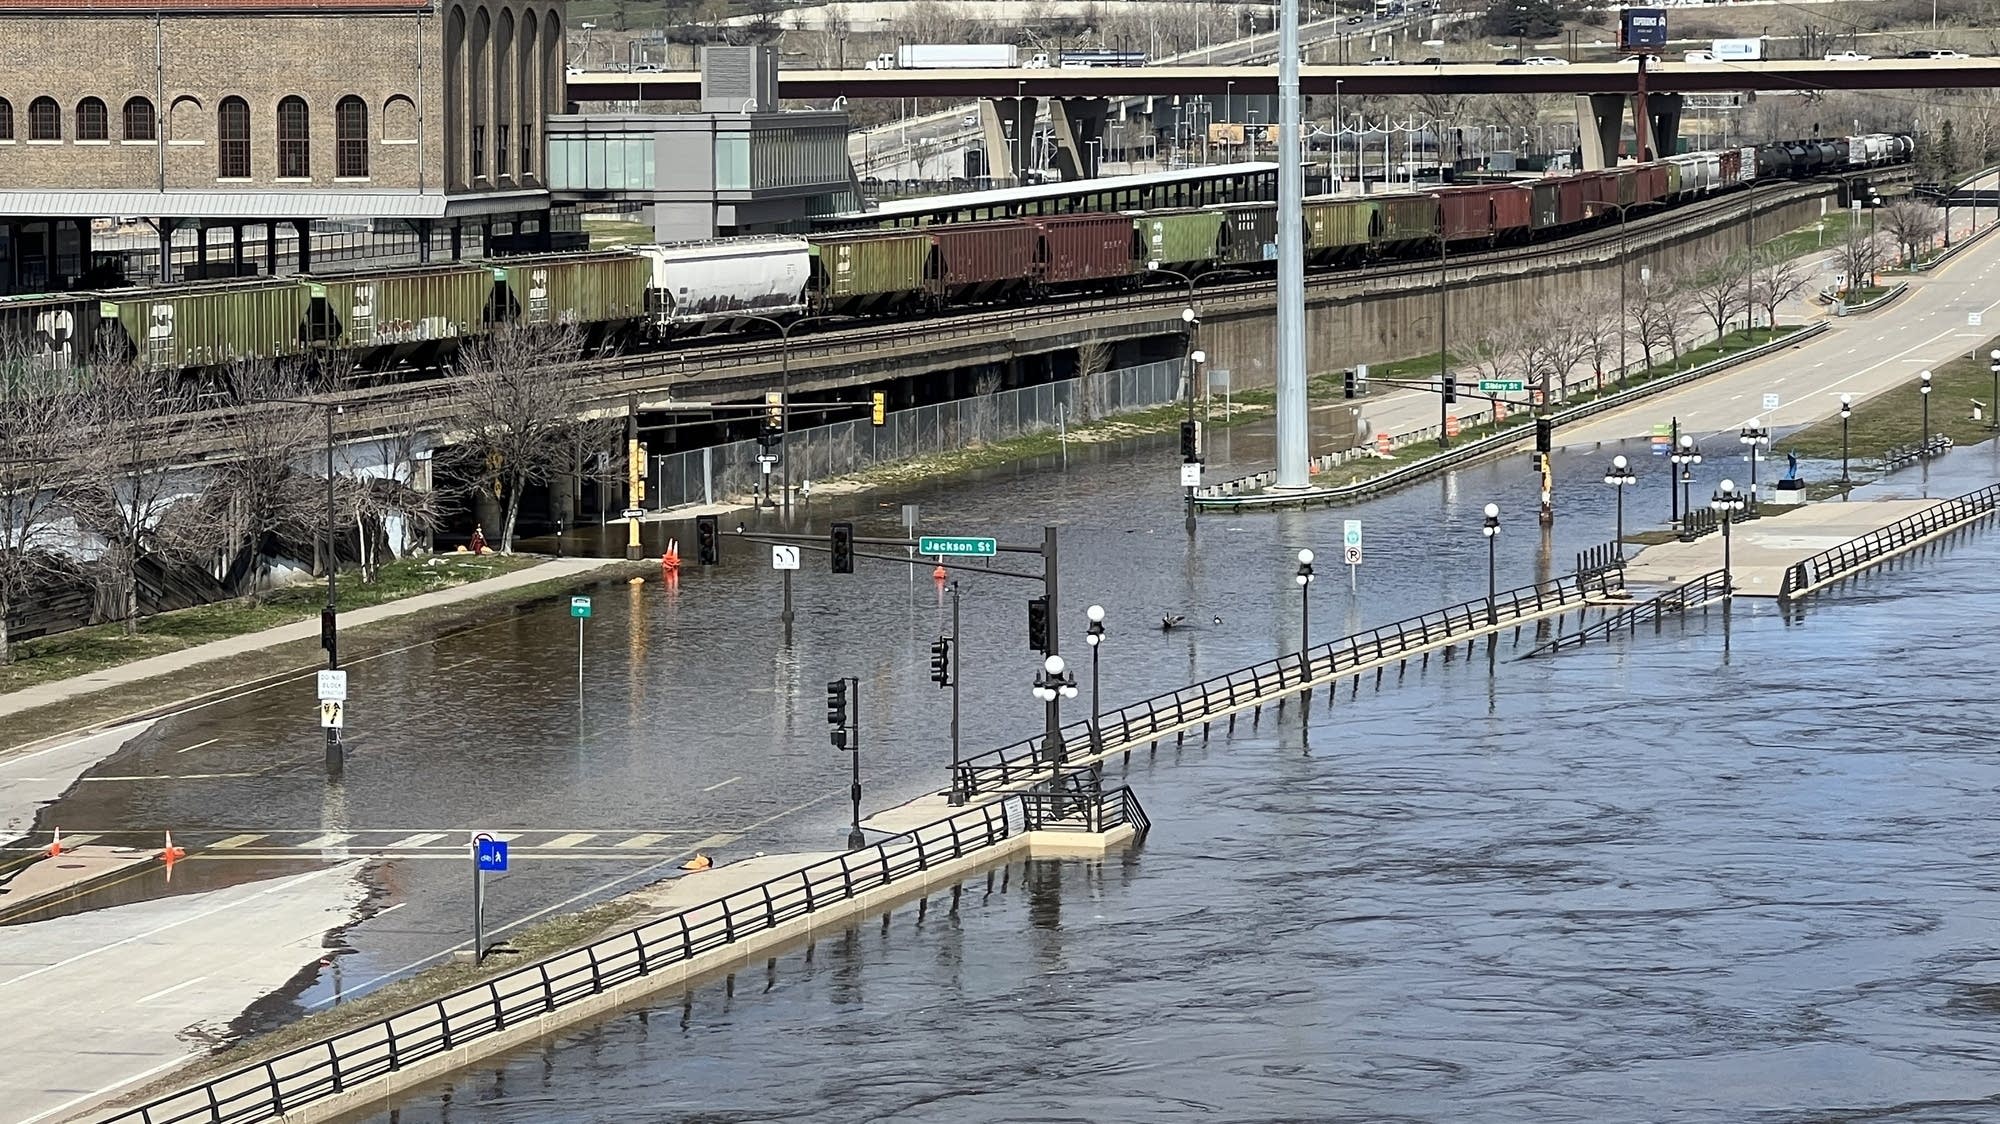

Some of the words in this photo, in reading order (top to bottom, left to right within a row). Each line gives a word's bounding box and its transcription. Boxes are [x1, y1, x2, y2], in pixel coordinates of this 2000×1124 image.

[1508, 382, 1518, 390] St
[925, 541, 973, 552] Jackson
[977, 541, 991, 552] St
